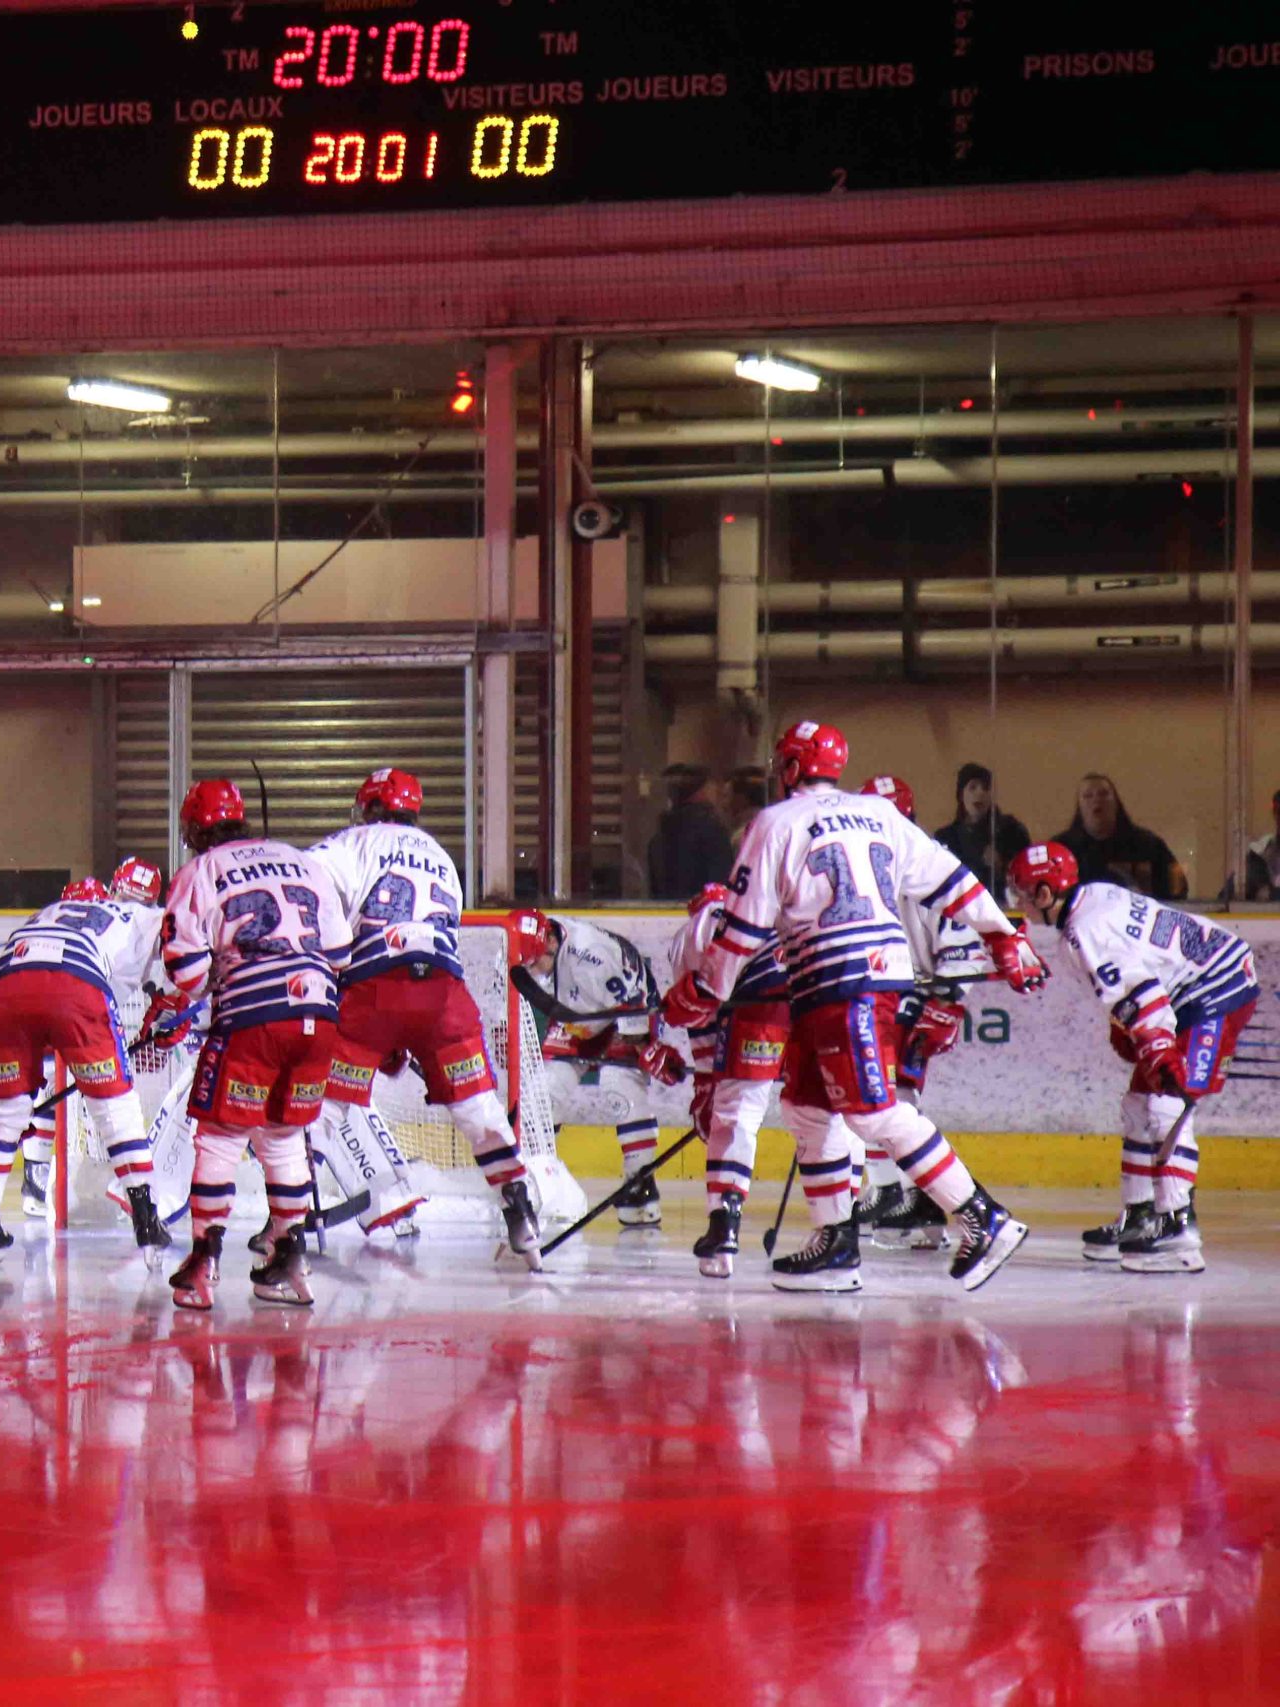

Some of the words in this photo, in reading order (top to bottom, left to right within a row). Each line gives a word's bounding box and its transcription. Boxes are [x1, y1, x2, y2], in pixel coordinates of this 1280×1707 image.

[273, 18, 471, 89] 20:00
[540, 31, 578, 55] TM
[222, 48, 259, 71] TM
[1023, 49, 1156, 80] PRISONS
[596, 73, 728, 103] JOUEURS
[766, 62, 916, 94] VISITEURS
[175, 94, 284, 123] LOCAUX
[442, 82, 585, 111] VISITEURS
[29, 102, 152, 129] JOUEURS
[188, 127, 274, 190] 00
[471, 113, 559, 178] 00
[215, 862, 309, 895] SCHMIT
[368, 1113, 405, 1167] CCM
